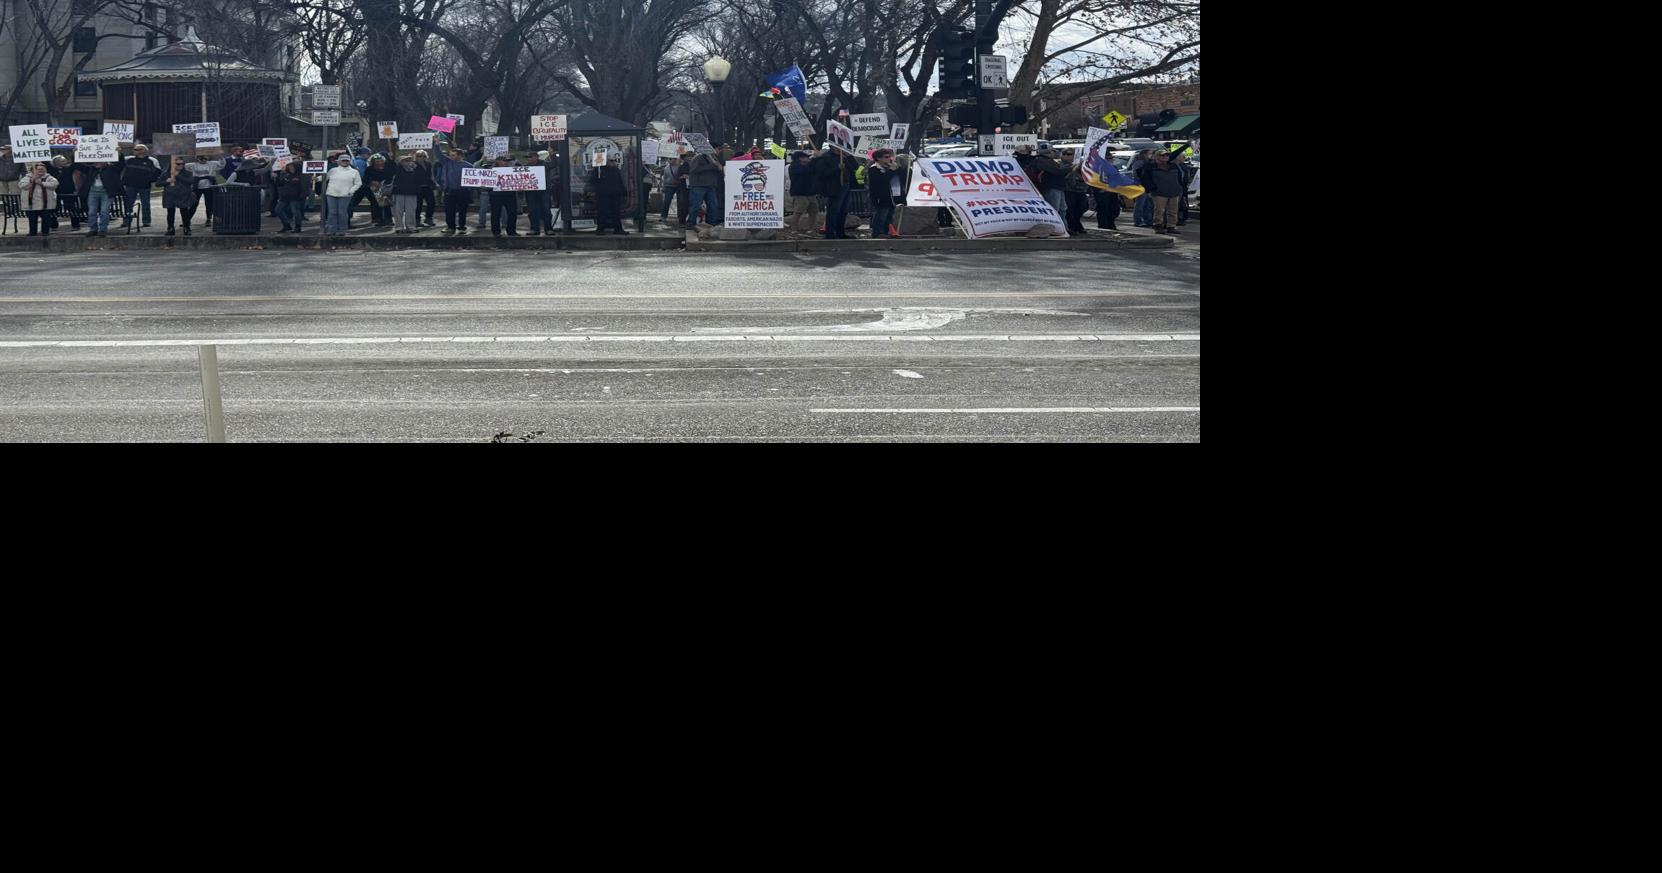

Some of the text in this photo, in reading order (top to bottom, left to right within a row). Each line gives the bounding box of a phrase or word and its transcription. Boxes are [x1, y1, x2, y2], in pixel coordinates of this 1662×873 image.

[984, 75, 992, 84] OK
[16, 138, 46, 147] LIVES
[13, 150, 50, 159] MATTER
[932, 160, 1014, 174] DUMP
[942, 173, 1025, 187] TRUMP
[742, 192, 766, 201] FREE
[734, 201, 774, 210] AMERICA
[971, 206, 1055, 218] PRESIDENT
